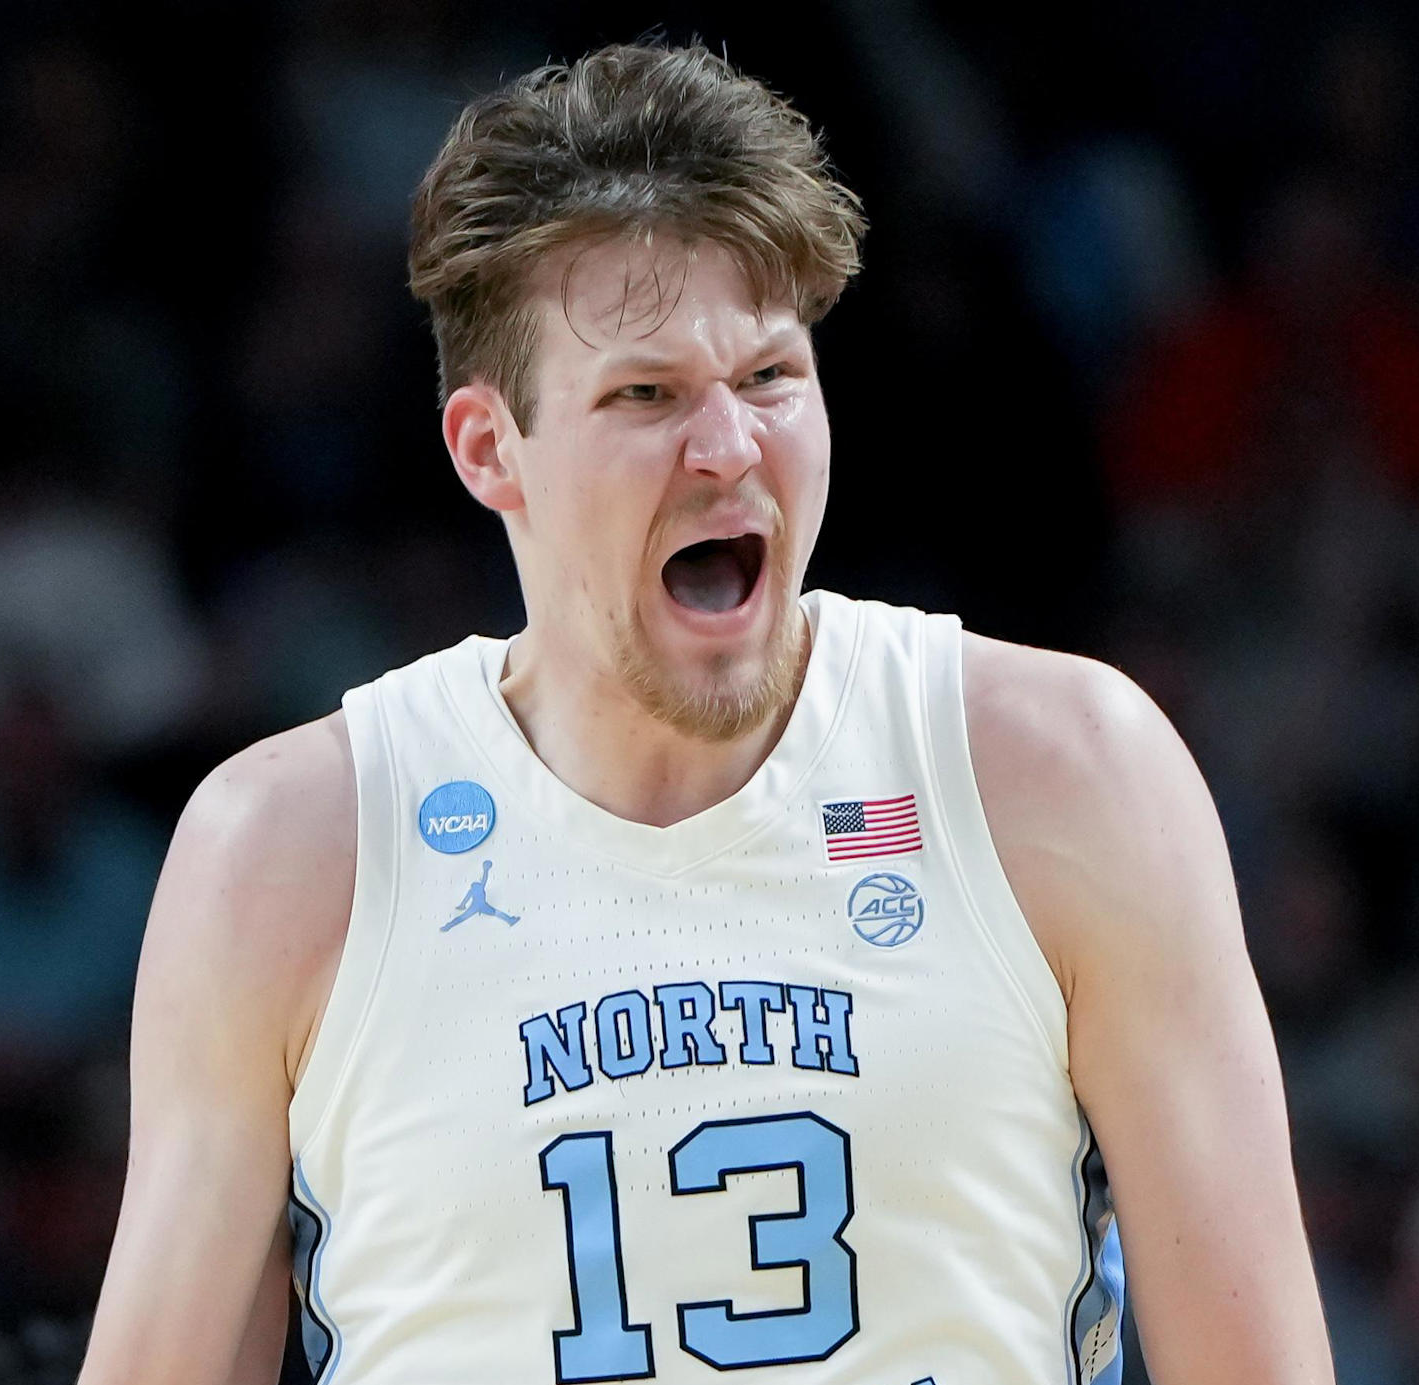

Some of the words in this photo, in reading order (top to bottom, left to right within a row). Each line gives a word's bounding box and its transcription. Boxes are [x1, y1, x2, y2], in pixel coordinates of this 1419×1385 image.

[427, 813, 488, 836] NCAA
[859, 894, 918, 917] ACC
[520, 981, 859, 1106] NORTH
[538, 1110, 861, 1385] 13
